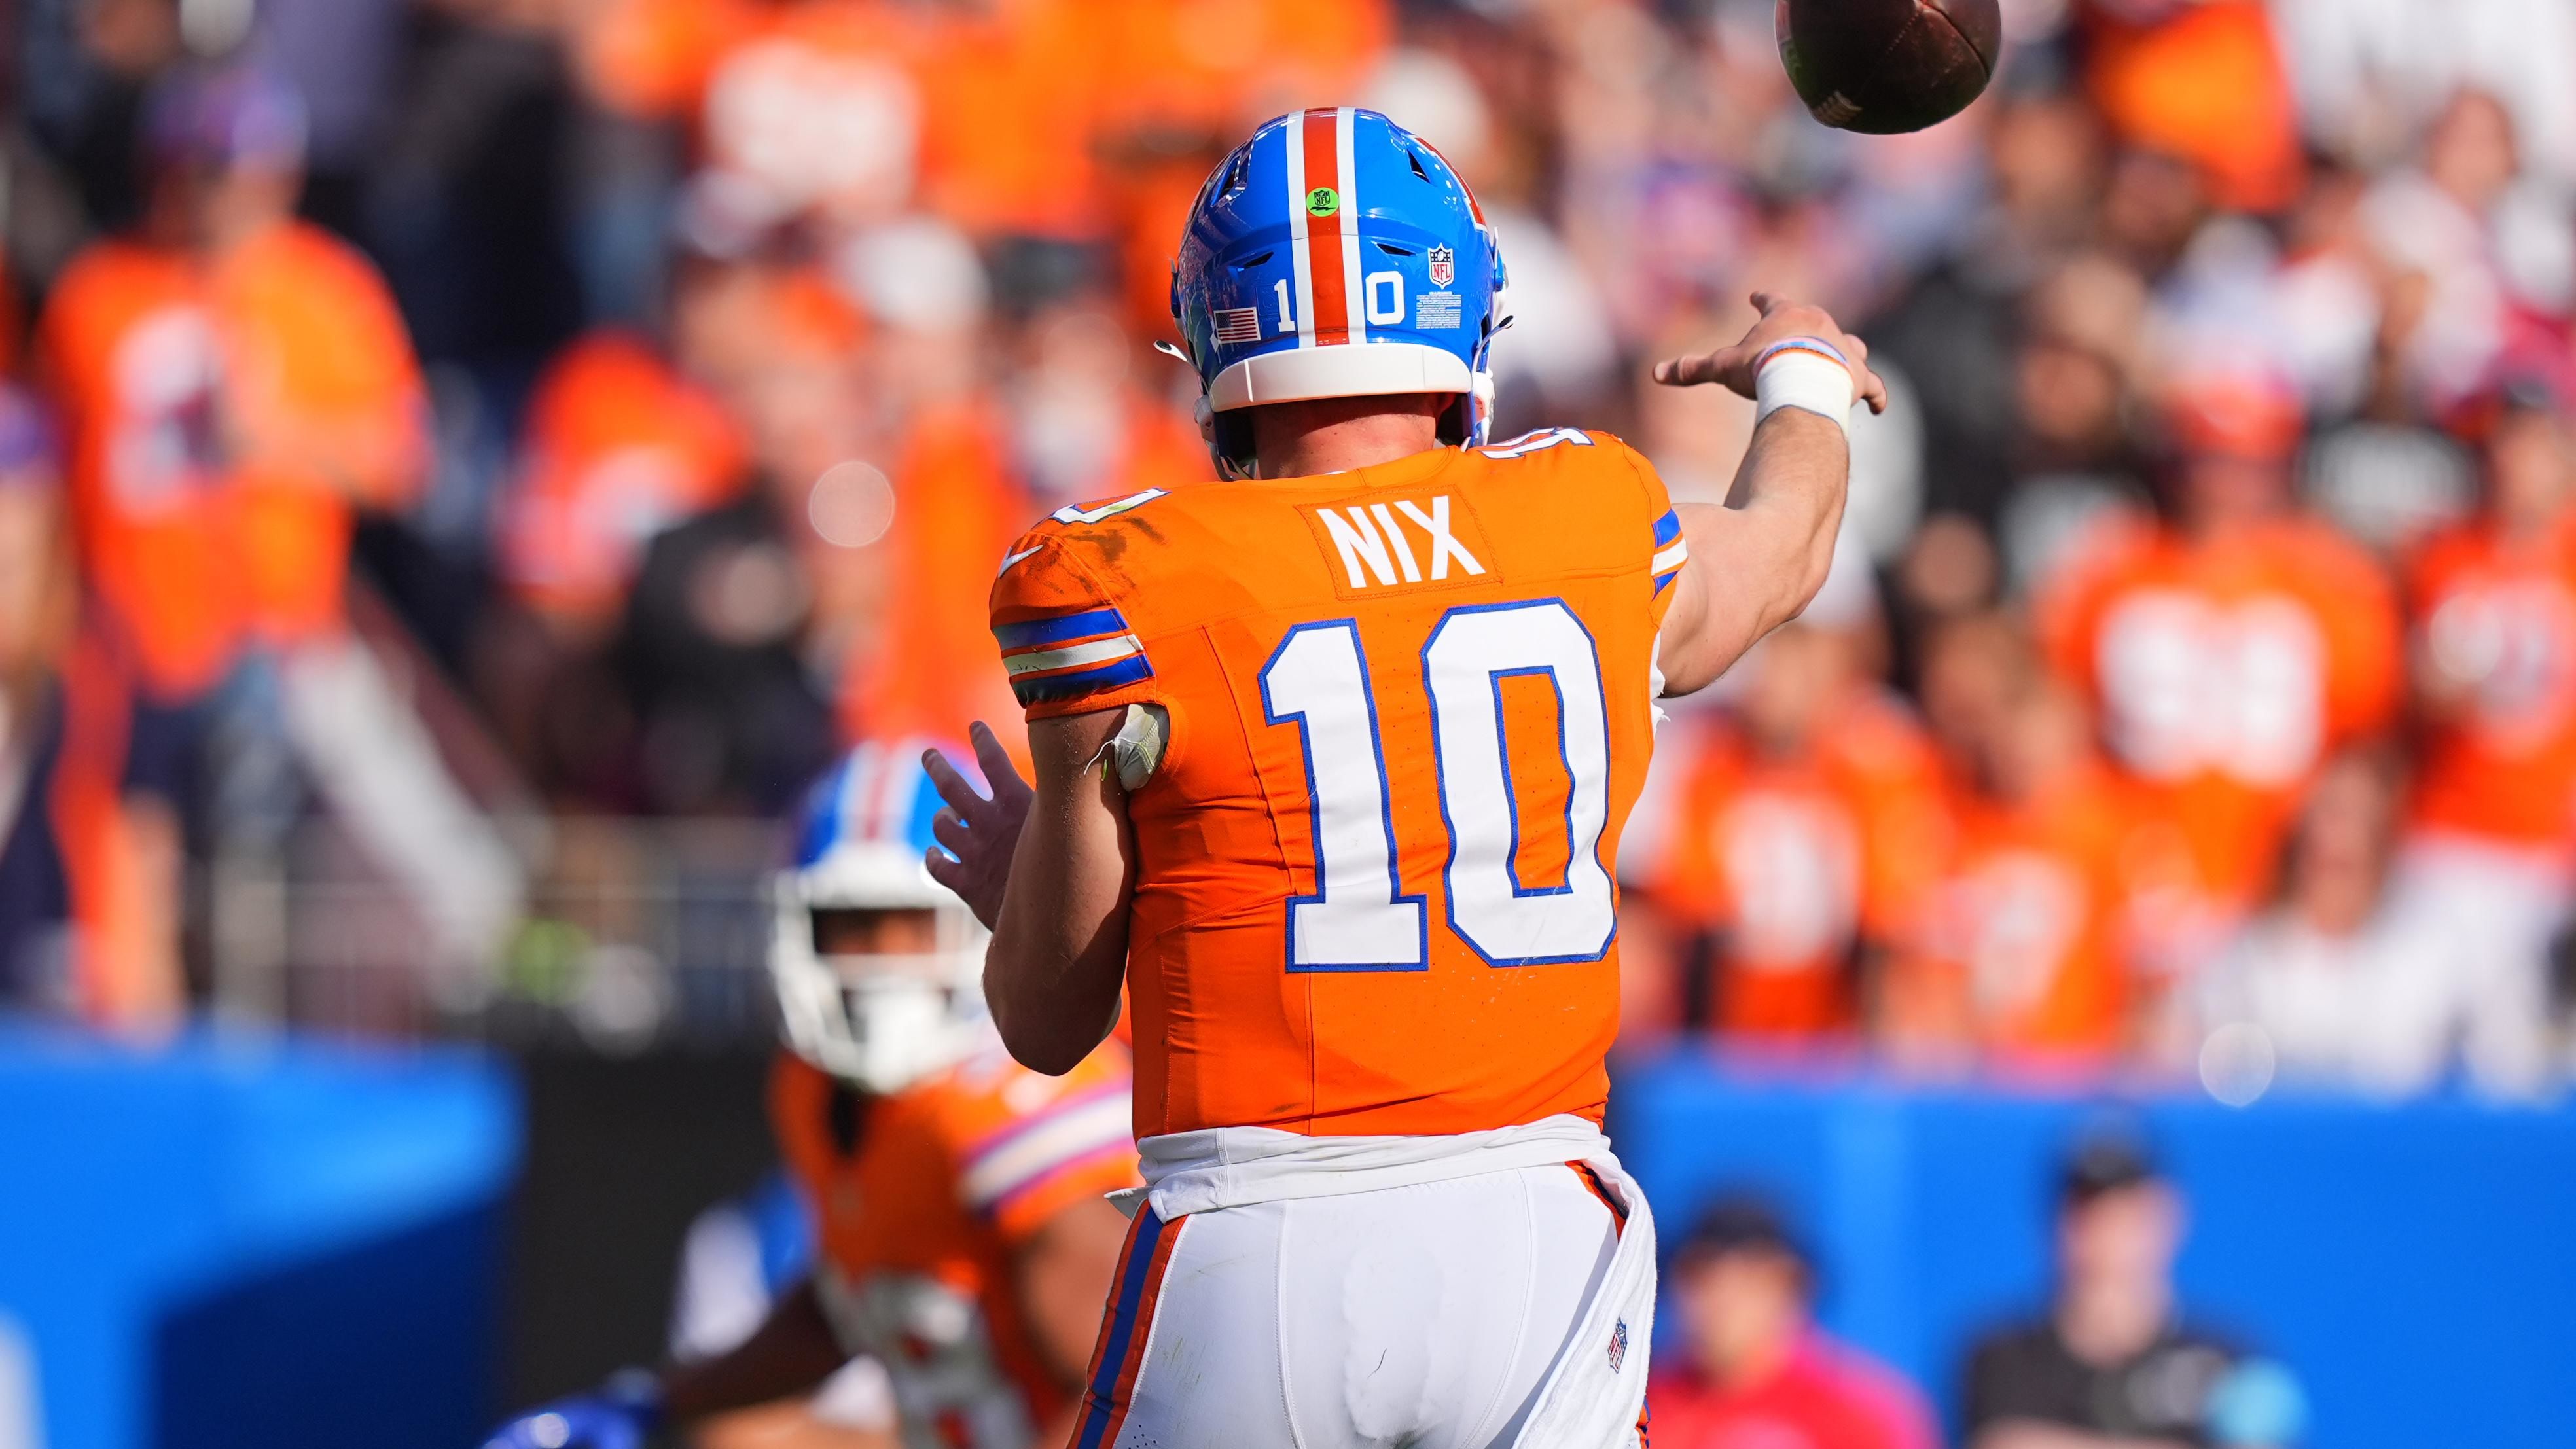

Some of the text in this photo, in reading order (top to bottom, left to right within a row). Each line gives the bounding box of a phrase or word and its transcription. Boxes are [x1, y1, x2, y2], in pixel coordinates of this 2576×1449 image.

[1433, 264, 1450, 281] NFL
[1317, 495, 1486, 589] NIX
[1257, 596, 1617, 973] 10
